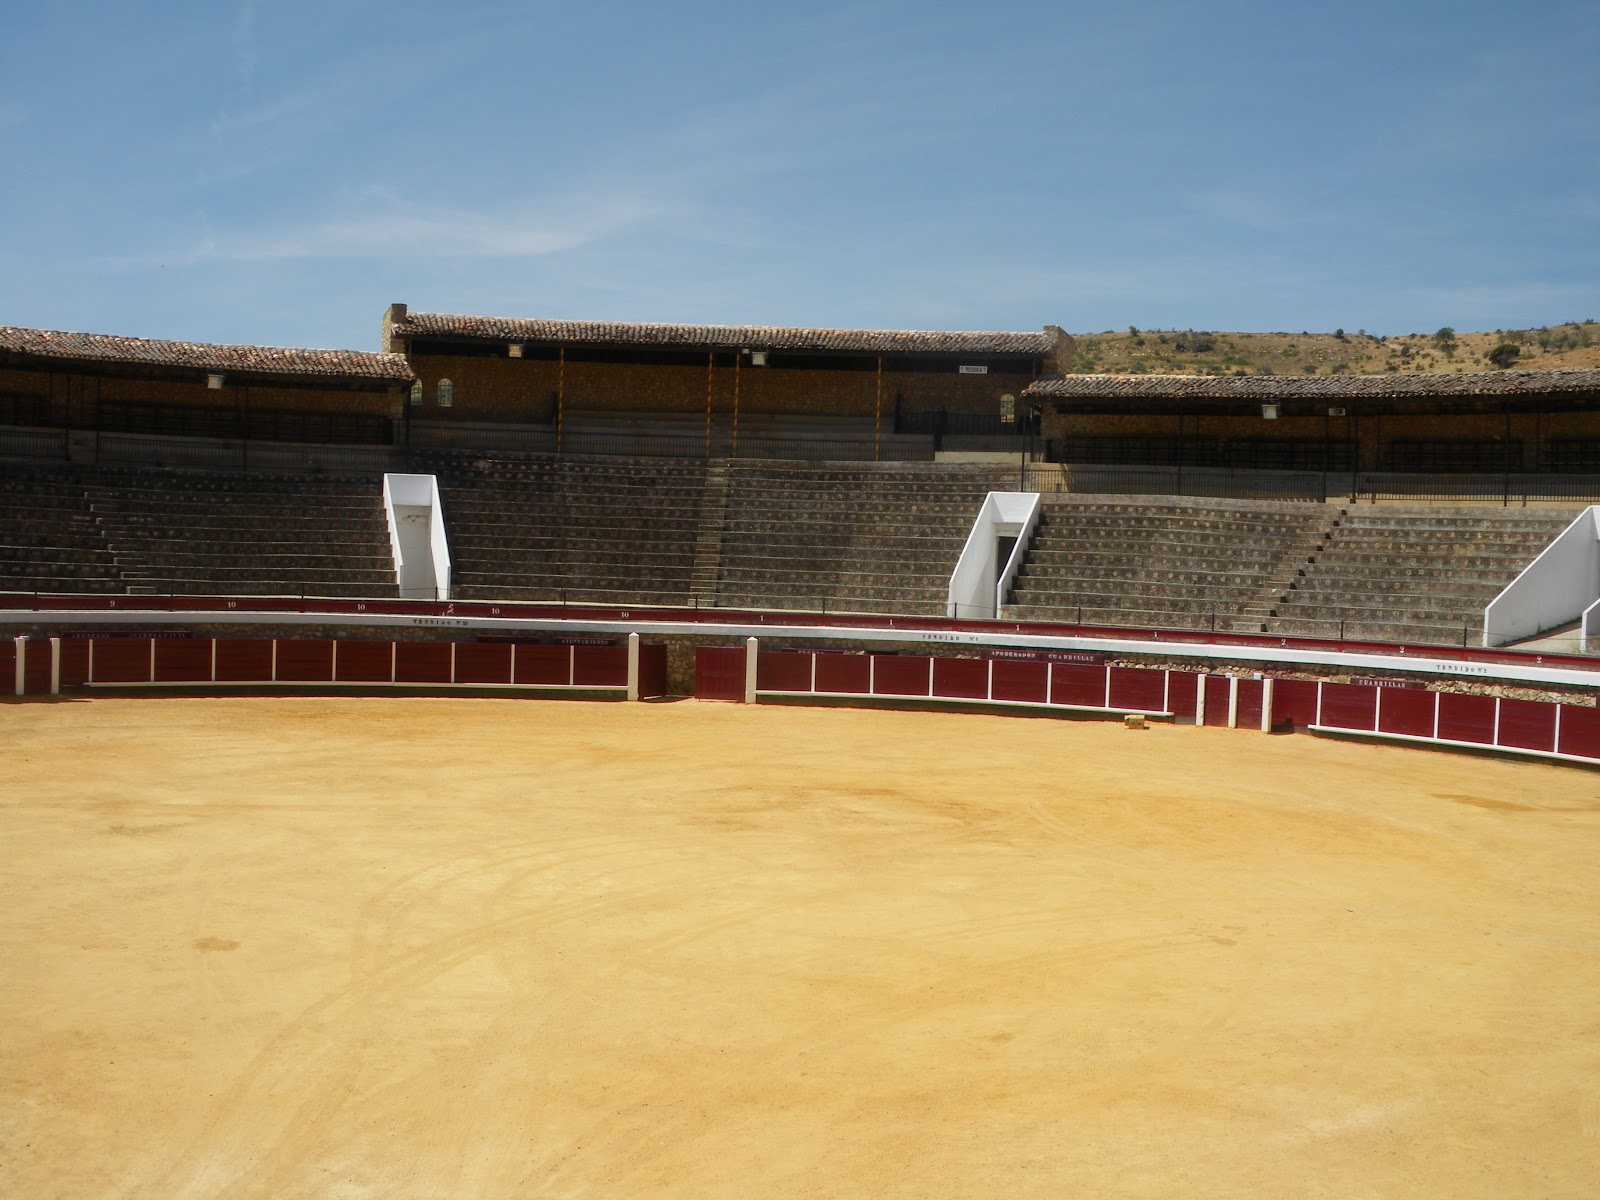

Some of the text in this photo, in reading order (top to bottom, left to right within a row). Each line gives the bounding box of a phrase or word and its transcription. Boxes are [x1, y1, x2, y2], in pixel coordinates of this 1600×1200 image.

[227, 601, 237, 609] 10
[356, 603, 366, 611] 10
[491, 607, 501, 615] 10
[621, 611, 630, 619] 10
[413, 618, 451, 626] TENDIDO
[922, 634, 960, 642] TENDIDO
[1281, 638, 1287, 646] 2
[991, 650, 1036, 659] APODERADOS
[1048, 653, 1095, 662] CUADRILLAS
[1436, 664, 1475, 673] TENDIDO
[1358, 679, 1406, 688] CUADRILLAS
